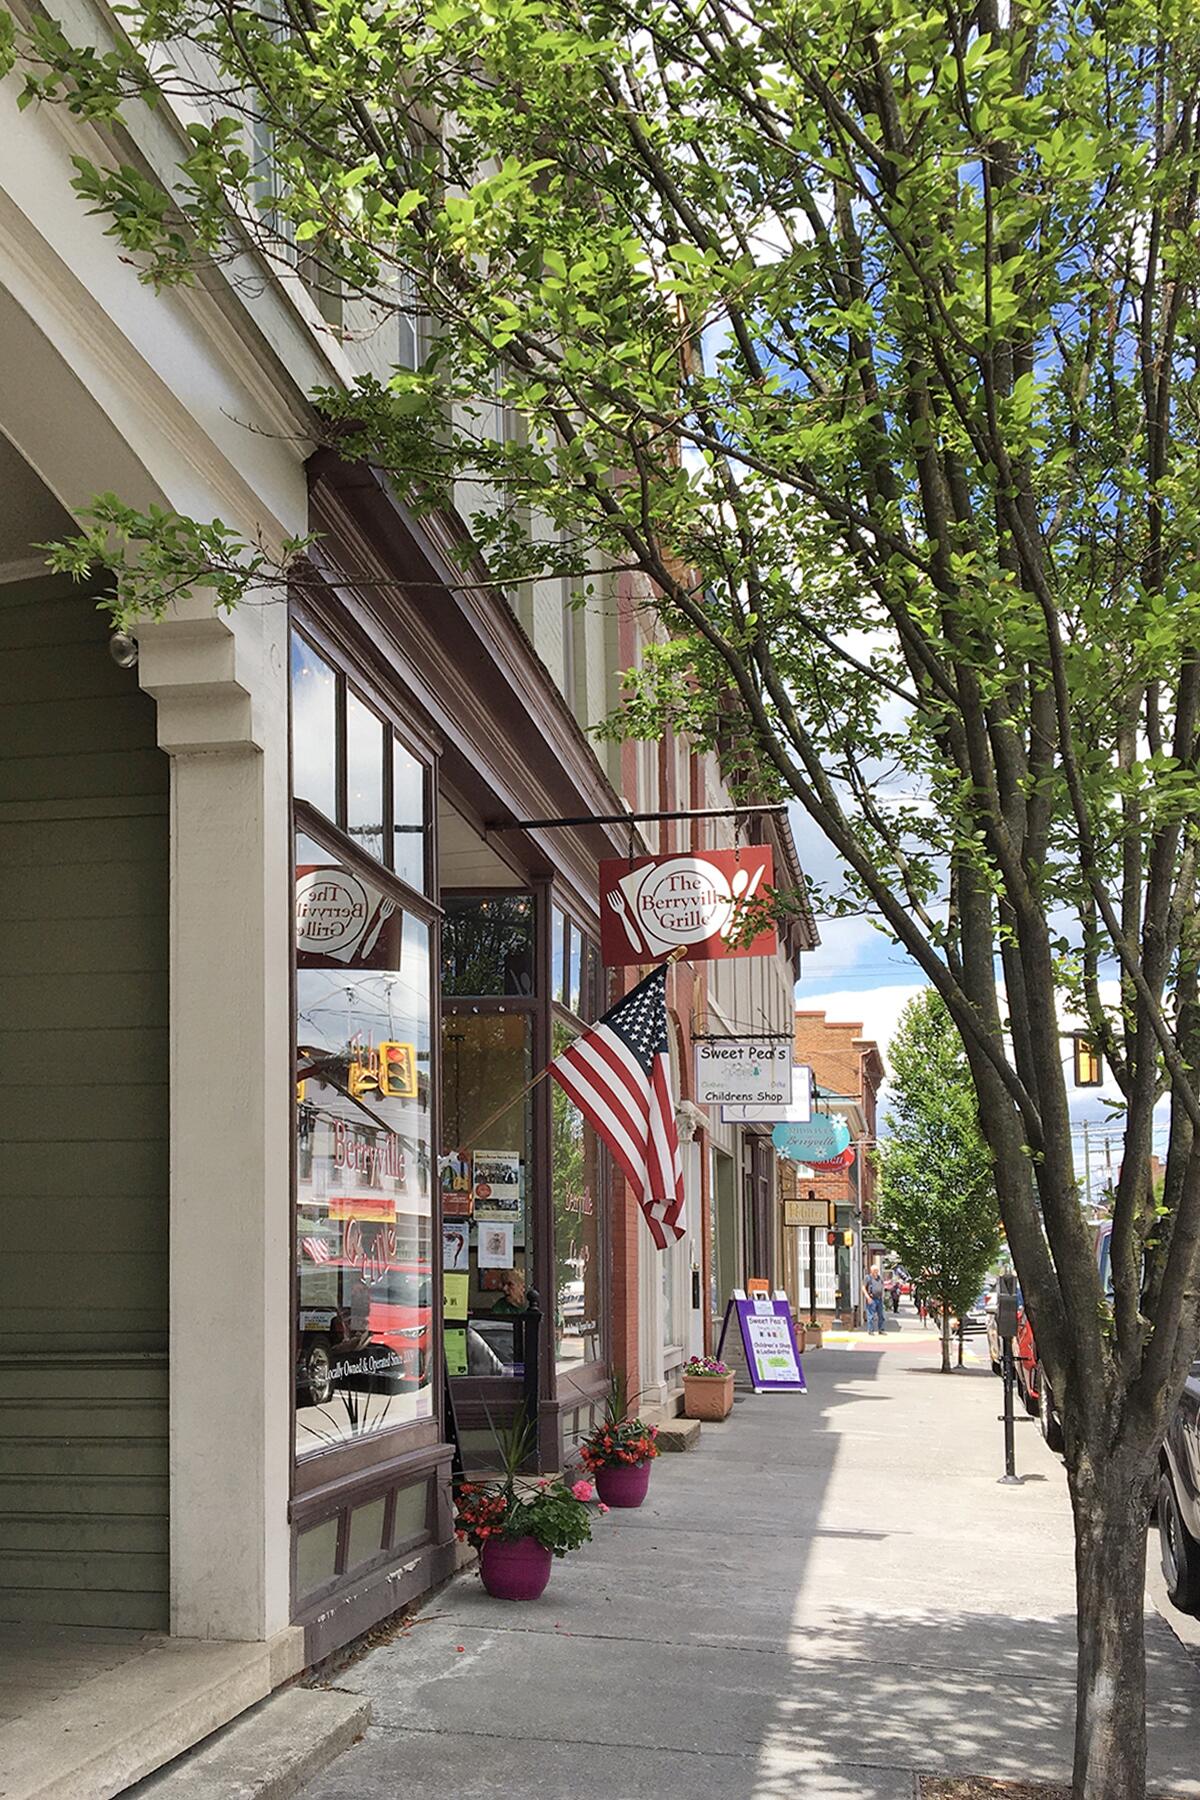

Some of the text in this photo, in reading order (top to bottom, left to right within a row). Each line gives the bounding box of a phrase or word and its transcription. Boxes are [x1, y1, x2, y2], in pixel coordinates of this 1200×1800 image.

[668, 875, 701, 891] The
[642, 889, 727, 911] Berryville
[660, 910, 710, 929] Grille
[701, 1046, 786, 1060] Sweet Pea's
[705, 1092, 783, 1104] Childrens Shop
[333, 1119, 407, 1187] Berryville
